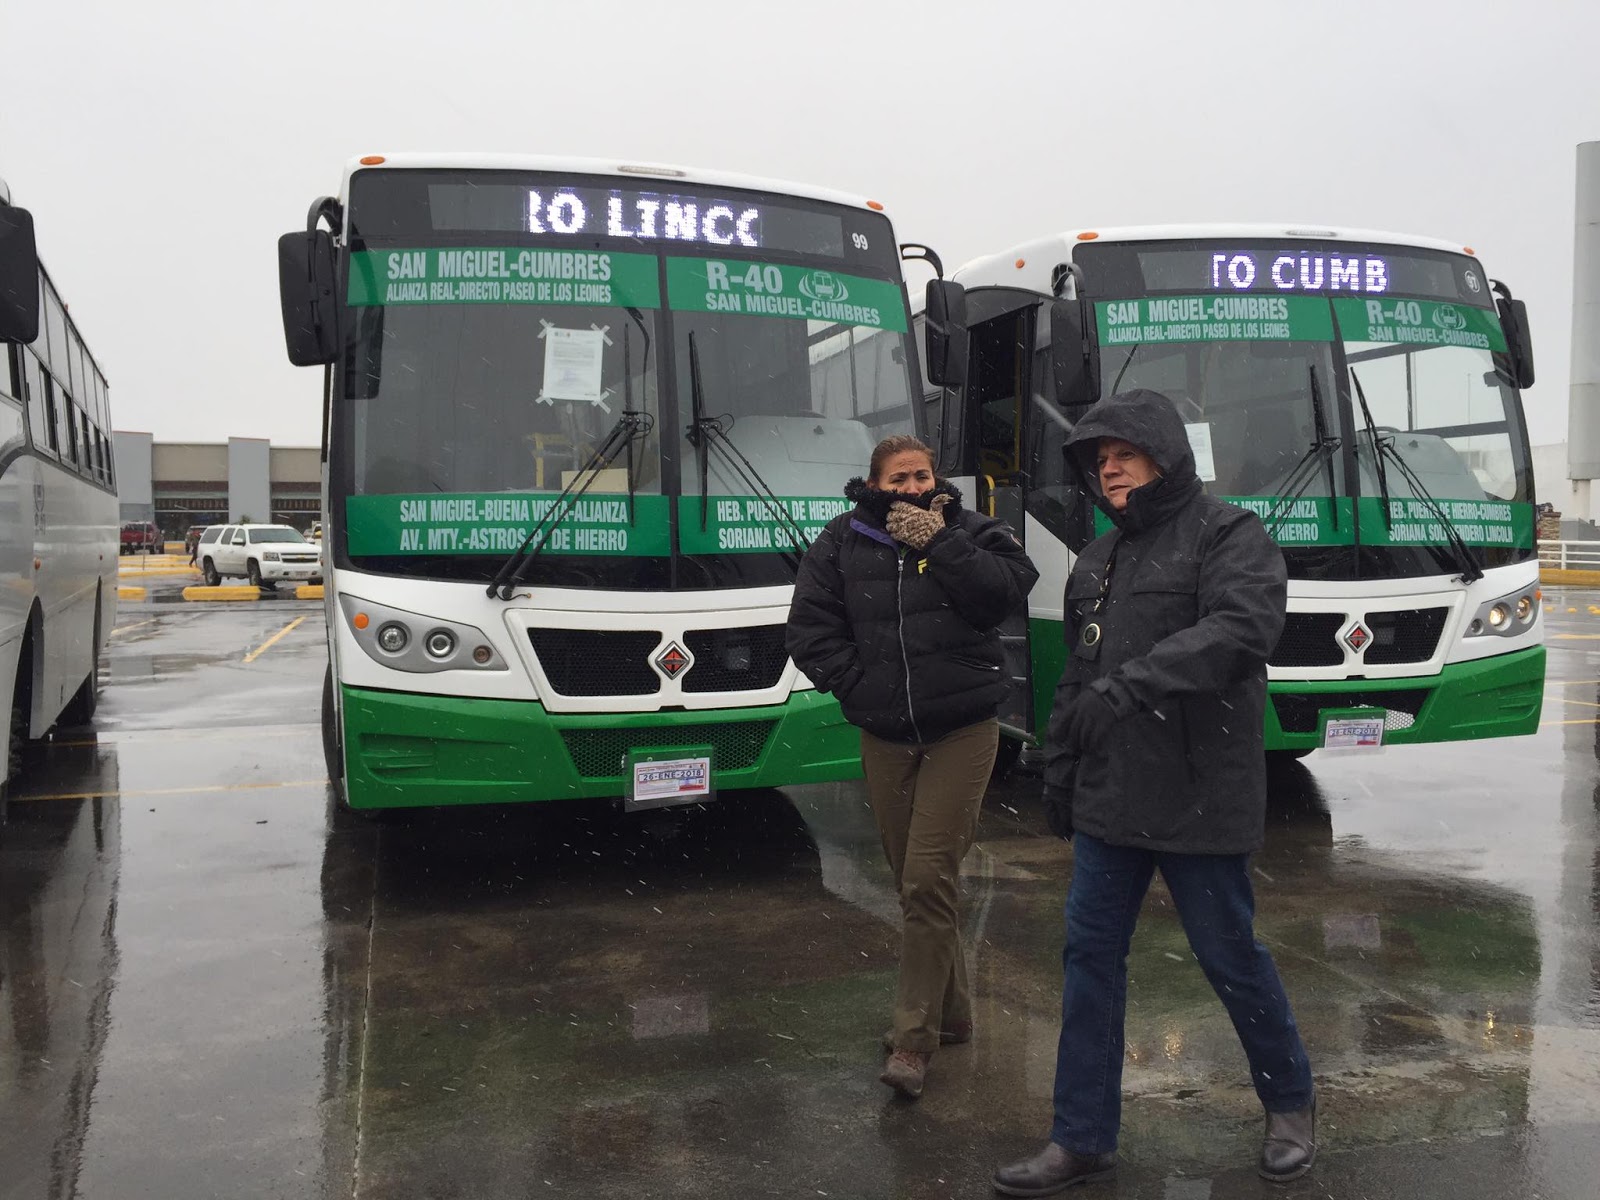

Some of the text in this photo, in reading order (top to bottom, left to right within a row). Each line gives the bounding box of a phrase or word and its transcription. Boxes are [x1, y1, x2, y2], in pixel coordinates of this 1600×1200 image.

[852, 233, 869, 250] 99
[388, 251, 611, 281] SAN MIGUEL-CUMBRES
[706, 261, 783, 294] R-40
[387, 282, 612, 303] ALIANZA REAL-DIRECTO PASEO DE LOS LEONES
[706, 293, 881, 326] SAN MIGUEL-CUMBRES
[1107, 298, 1288, 325] SAN MIGUEL-CUMBRES
[1365, 300, 1422, 325] R-40
[1108, 322, 1290, 343] ALIANZA REAL-DIRECTO PASEO DE LOS LEONES
[1368, 326, 1490, 348] SAN MIGUEL-CUMBRES
[400, 499, 628, 523] SAN MIGUEL-BUENA VISTA-ALIANZA
[717, 501, 744, 521] HEB.
[792, 500, 806, 520] DE
[1451, 502, 1511, 521] HIERRO-CUMBRES
[400, 529, 424, 551] AV.
[552, 529, 570, 550] DE
[575, 529, 628, 551] HIERRO
[719, 527, 772, 549] SORIANA
[1277, 523, 1319, 541] HIERRO
[1389, 524, 1427, 541] SORIANA
[1485, 525, 1513, 542] LINCOLN
